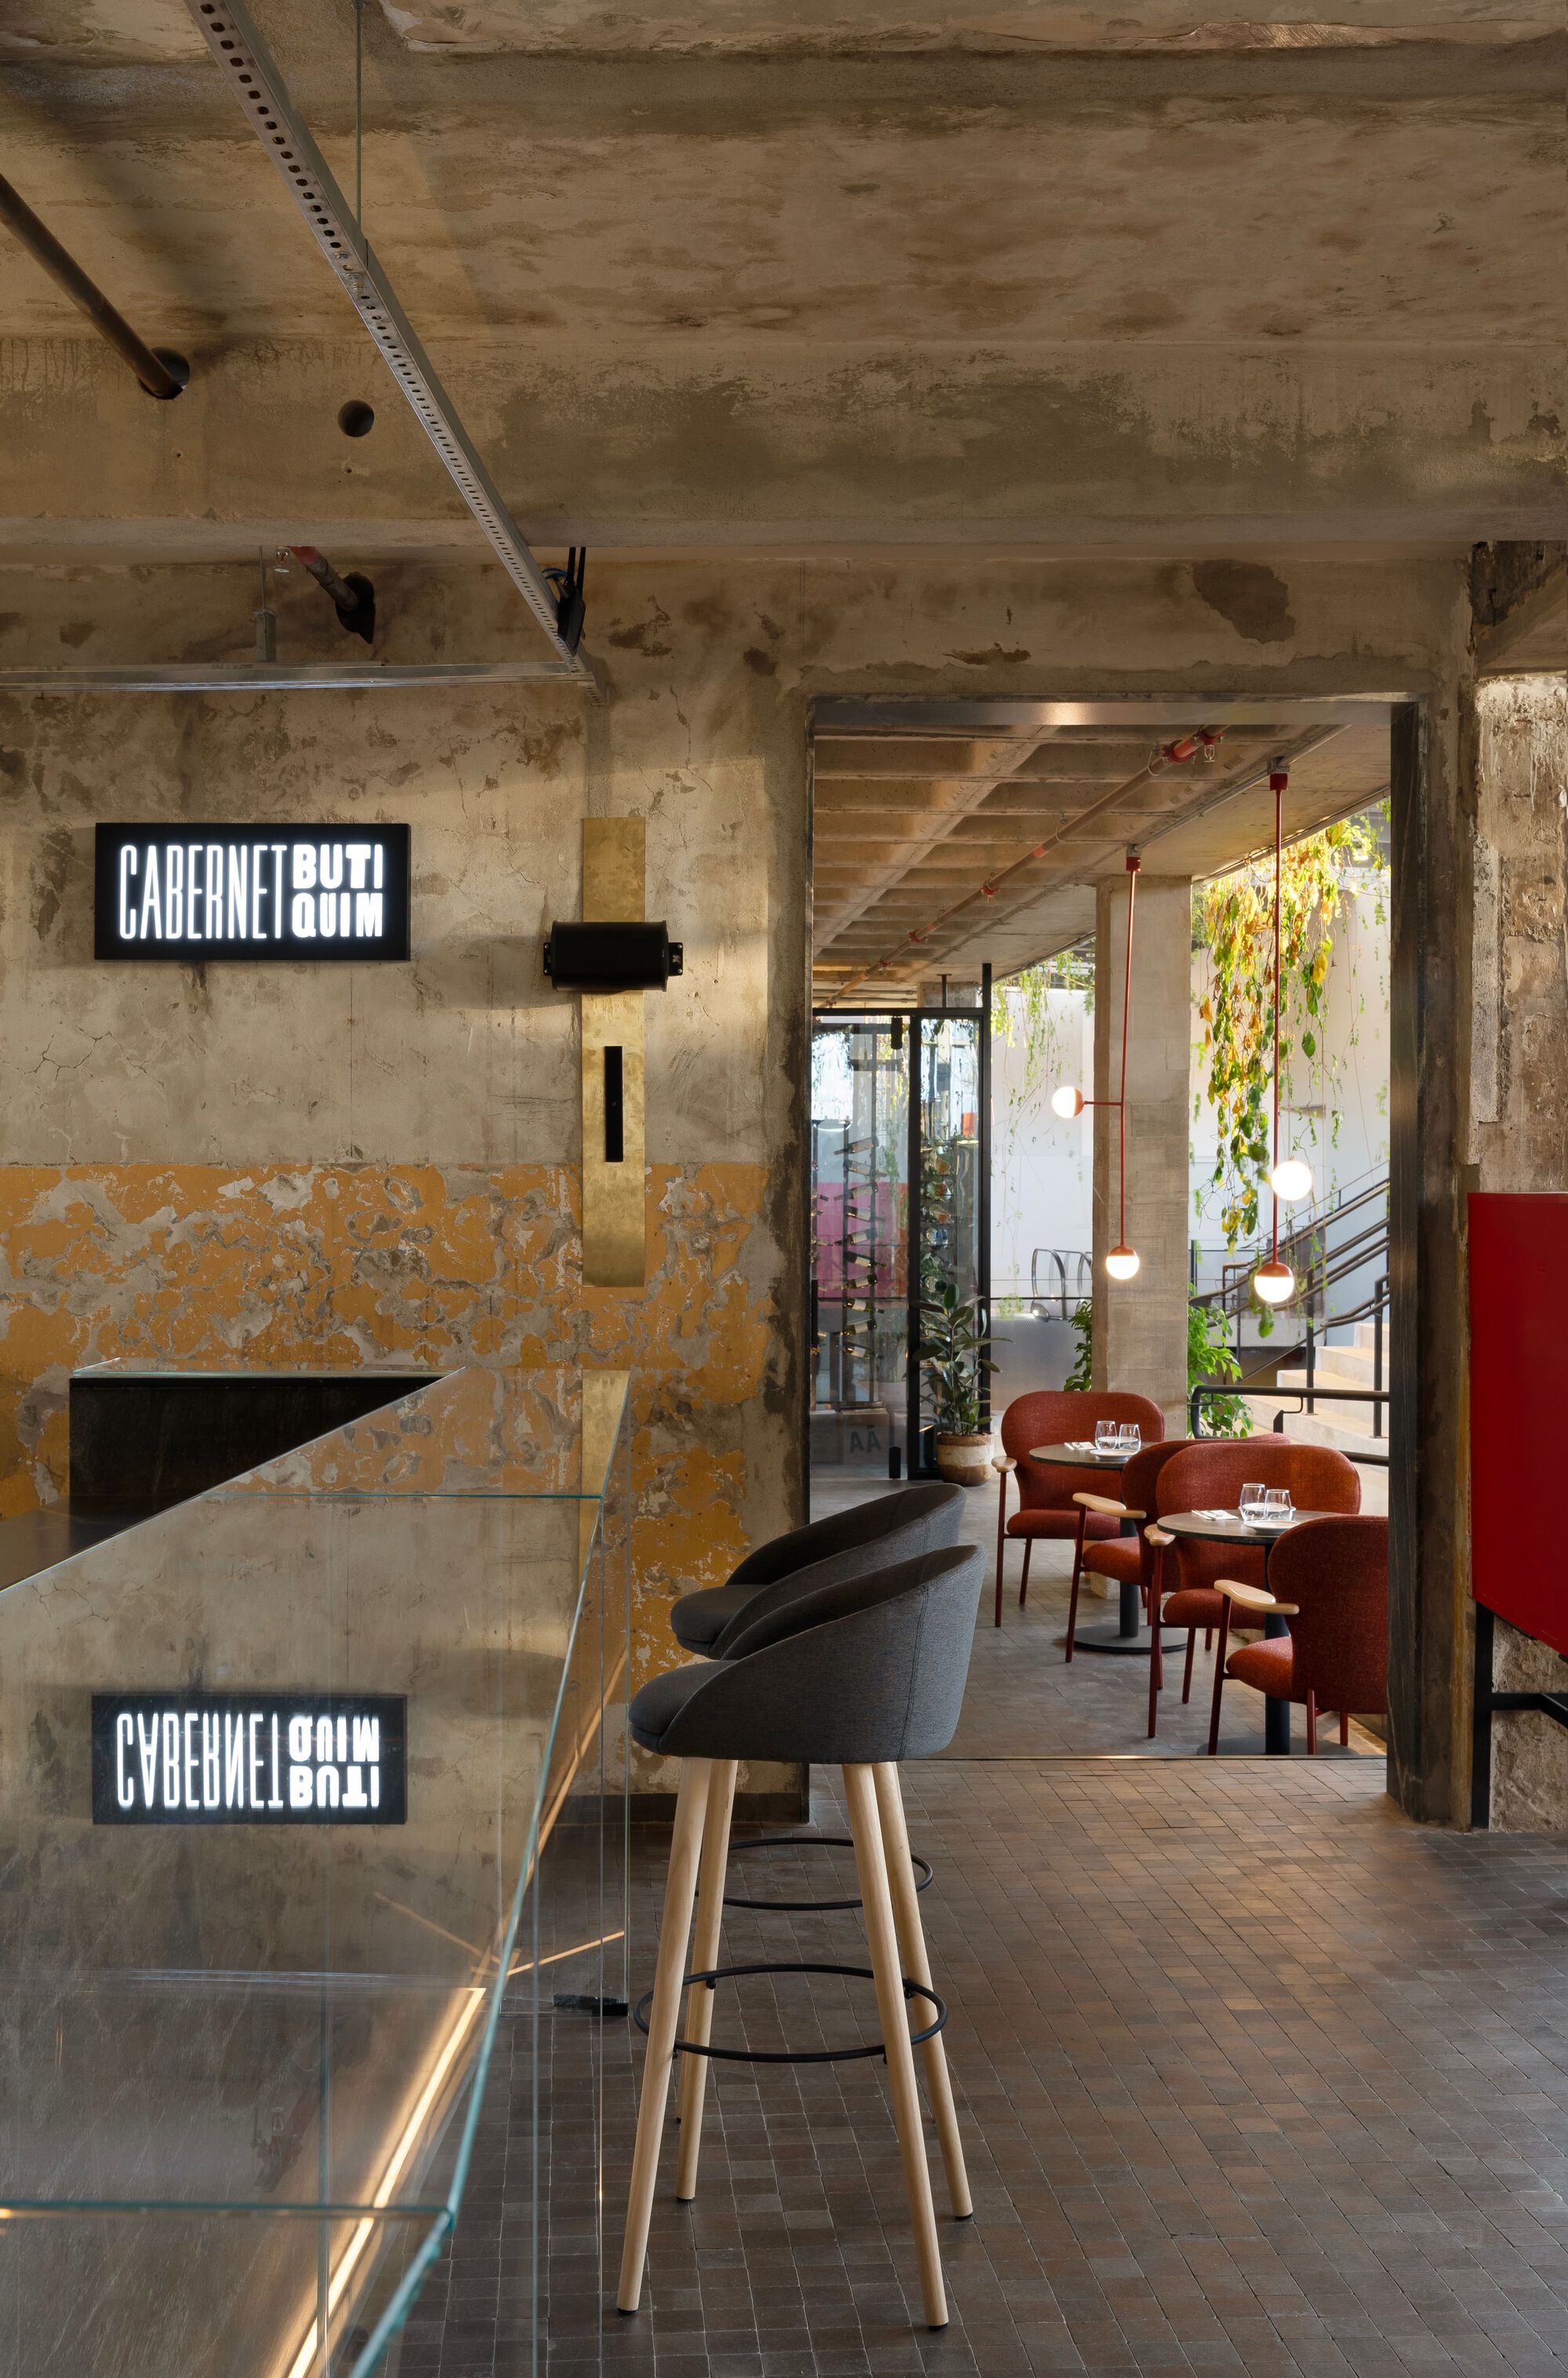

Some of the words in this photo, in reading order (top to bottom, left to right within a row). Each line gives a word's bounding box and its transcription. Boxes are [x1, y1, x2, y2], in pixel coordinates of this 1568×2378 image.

[292, 844, 383, 889] BUTI
[119, 844, 288, 939] CABERNET
[292, 892, 383, 938] QUIM
